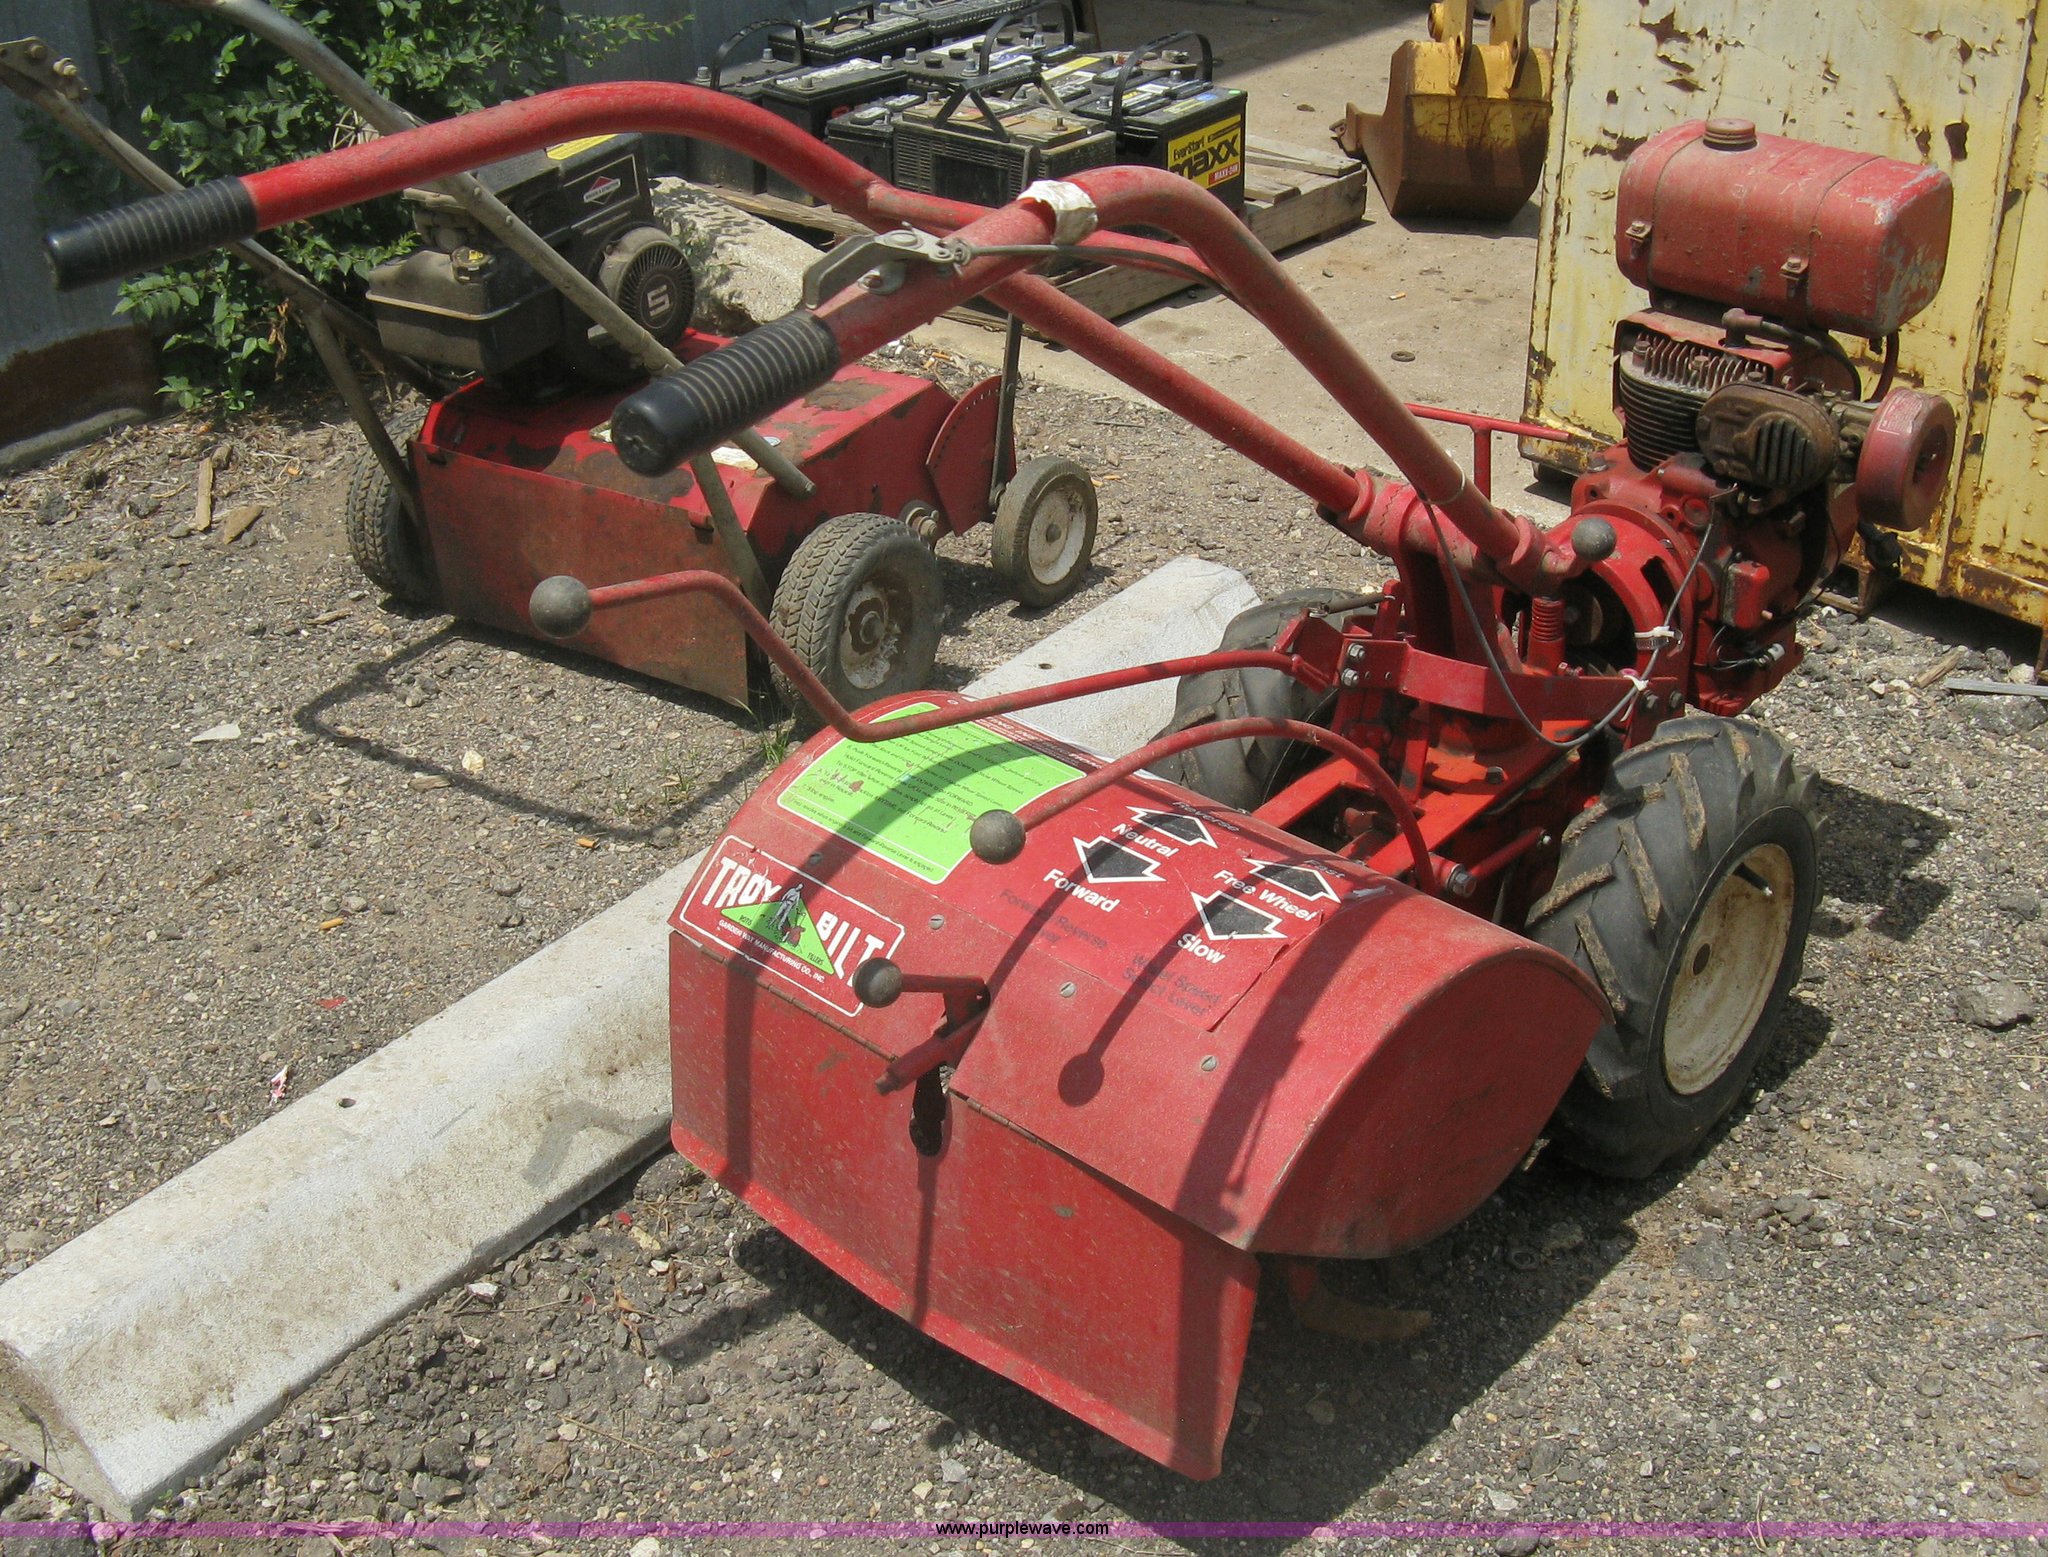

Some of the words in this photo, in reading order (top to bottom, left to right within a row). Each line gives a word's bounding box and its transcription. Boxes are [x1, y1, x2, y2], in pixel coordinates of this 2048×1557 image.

[1172, 801, 1240, 832] Reverse
[1111, 823, 1180, 858] Neutral
[701, 856, 783, 909] TROY
[1042, 868, 1121, 913] Forward
[1303, 859, 1346, 878] Fast
[1213, 869, 1257, 895] Free
[1258, 889, 1320, 922] Wheel
[718, 919, 743, 937] GARDEN
[754, 938, 802, 970] MANUFACTURING
[816, 910, 886, 988] BILT
[1177, 933, 1226, 964] Slow
